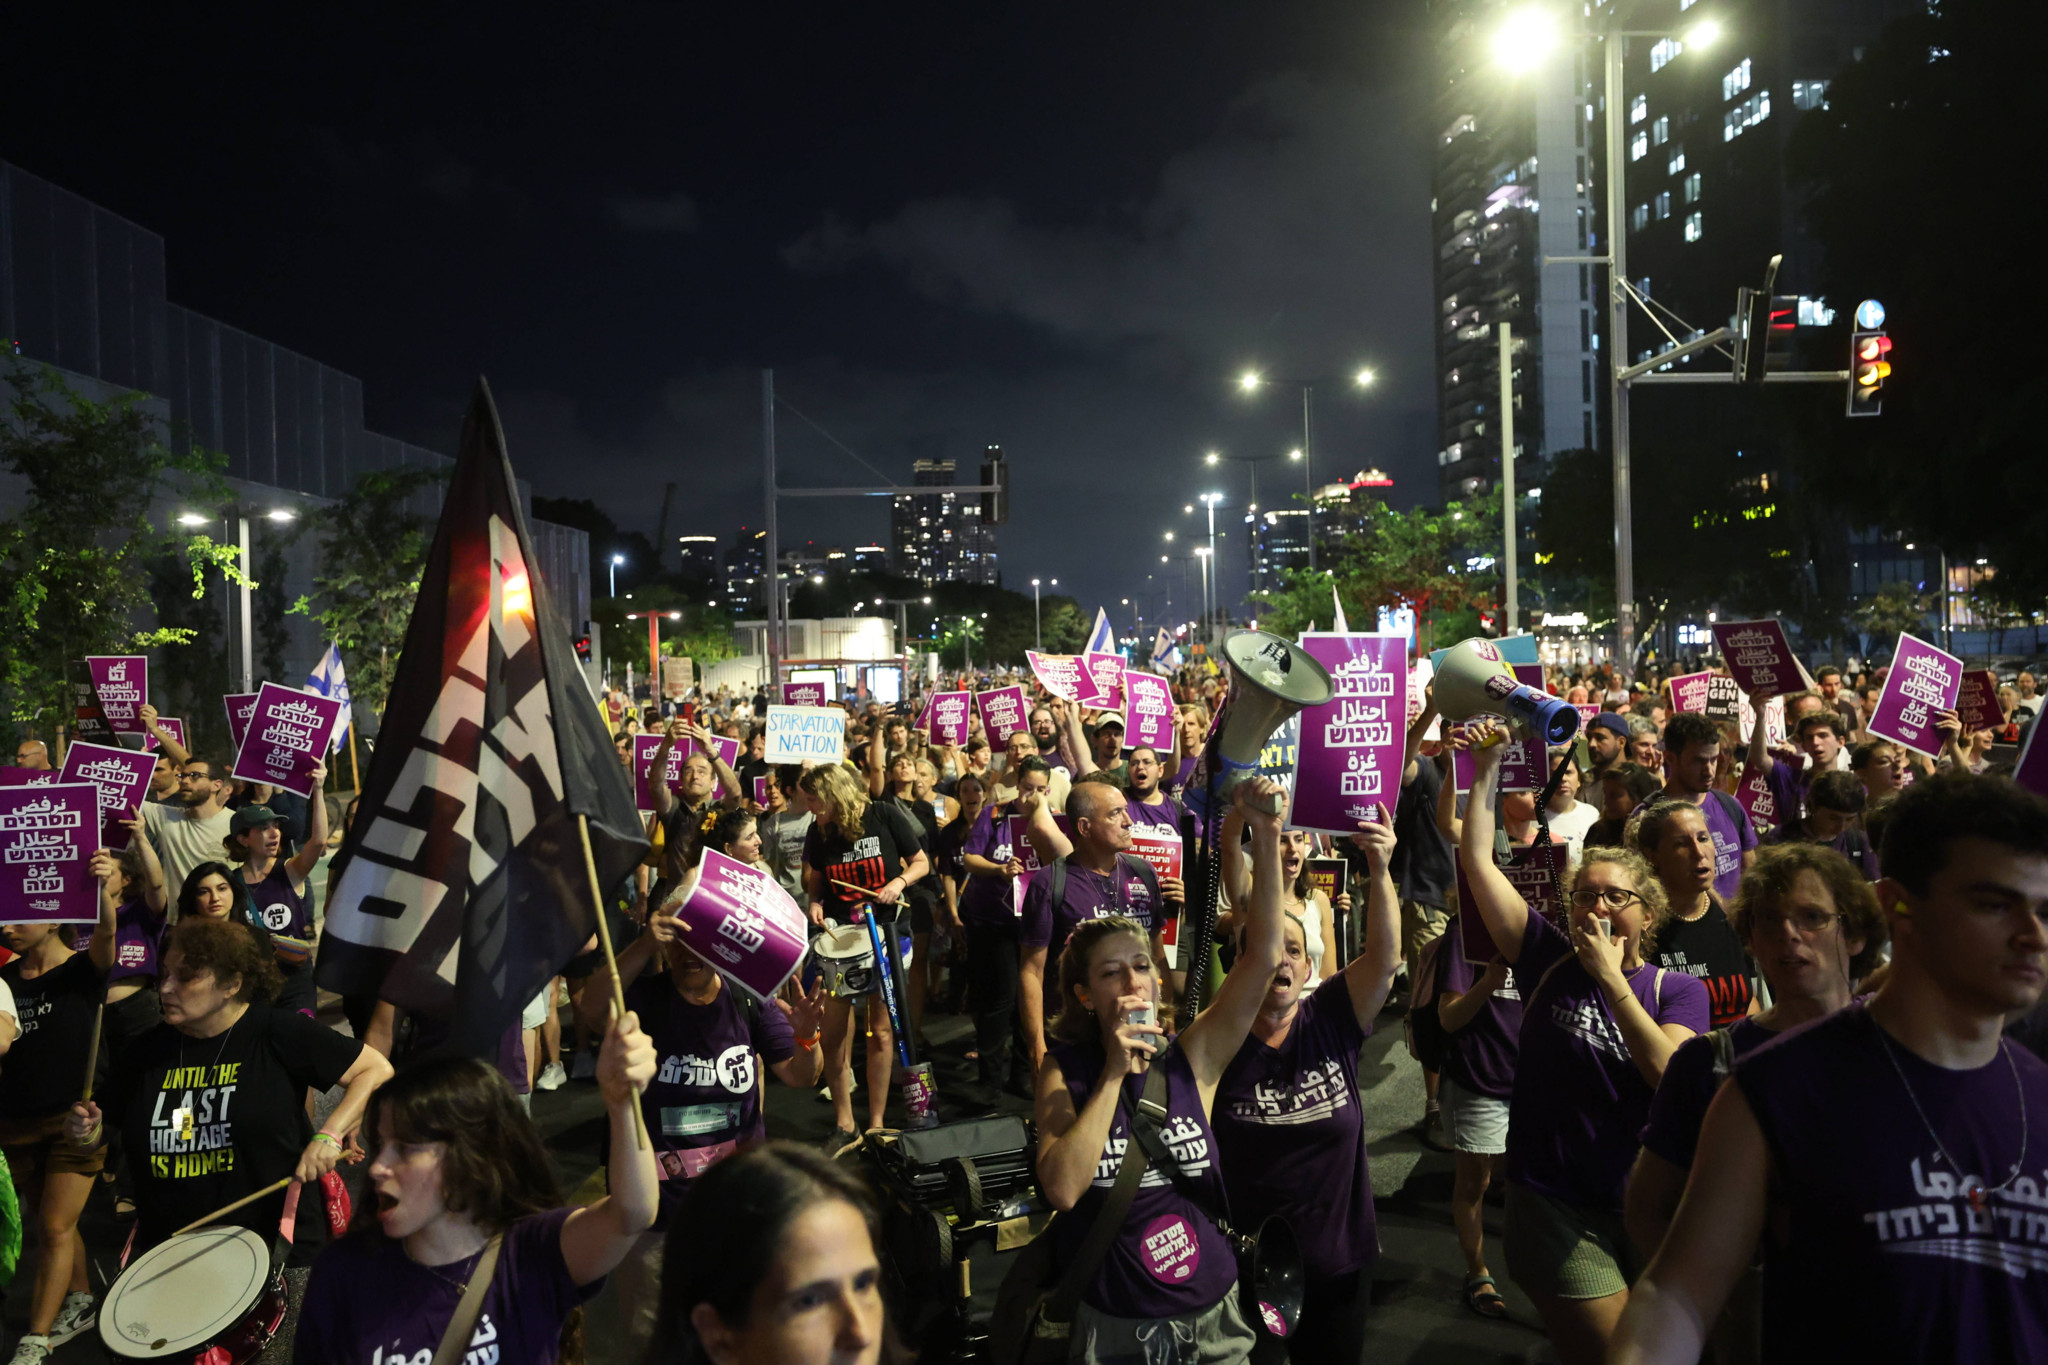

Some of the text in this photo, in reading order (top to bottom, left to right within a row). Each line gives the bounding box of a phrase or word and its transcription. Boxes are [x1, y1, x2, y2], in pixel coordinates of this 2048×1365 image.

[1334, 648, 1383, 677] نرفض
[1908, 659, 1950, 684] מסרבים
[1915, 654, 1947, 672] نرفض
[1709, 676, 1738, 688] STO
[1907, 673, 1944, 695] احتلال
[98, 690, 139, 700] להרעבה
[1903, 684, 1945, 707] לכיבוש
[106, 709, 133, 718] בעזה
[270, 706, 320, 727] מסרבים
[279, 700, 318, 715] نرفض
[1331, 698, 1387, 727] احتلال
[1902, 710, 1926, 725] עזה
[1908, 700, 1928, 715] غزة
[269, 720, 313, 740] احتلال
[768, 713, 844, 734] STARVATION
[265, 731, 310, 750] לכיבוש
[778, 734, 837, 754] NATION
[1329, 724, 1389, 744] לכיבוש
[266, 755, 292, 768] עזה
[272, 745, 293, 759] غزة
[1347, 748, 1377, 776] غزة
[80, 765, 136, 783] מסרבים
[91, 757, 132, 772] نرفض
[1344, 774, 1379, 791] עזה
[12, 796, 67, 816] نرفض
[3, 813, 77, 829] מסרבים
[10, 829, 71, 849] احتلال
[8, 847, 74, 861] לכיבוש
[28, 862, 59, 880] غزة
[25, 879, 61, 892] עזה
[722, 919, 760, 948] עזה
[1660, 951, 1688, 967] BRING
[1687, 963, 1710, 978] HOME
[37, 1002, 52, 1016] לא
[162, 1061, 242, 1090] UNTIL THE
[658, 1063, 717, 1087] שלום
[150, 1085, 237, 1127] LAST
[1232, 1101, 1281, 1115] ביחד
[149, 1122, 233, 1154] HOSTAGE
[151, 1148, 235, 1179] IS HOME!
[1863, 1202, 1960, 1241] ביחד
[1145, 1221, 1185, 1251] מסרבים
[1151, 1233, 1189, 1262] למלחמה
